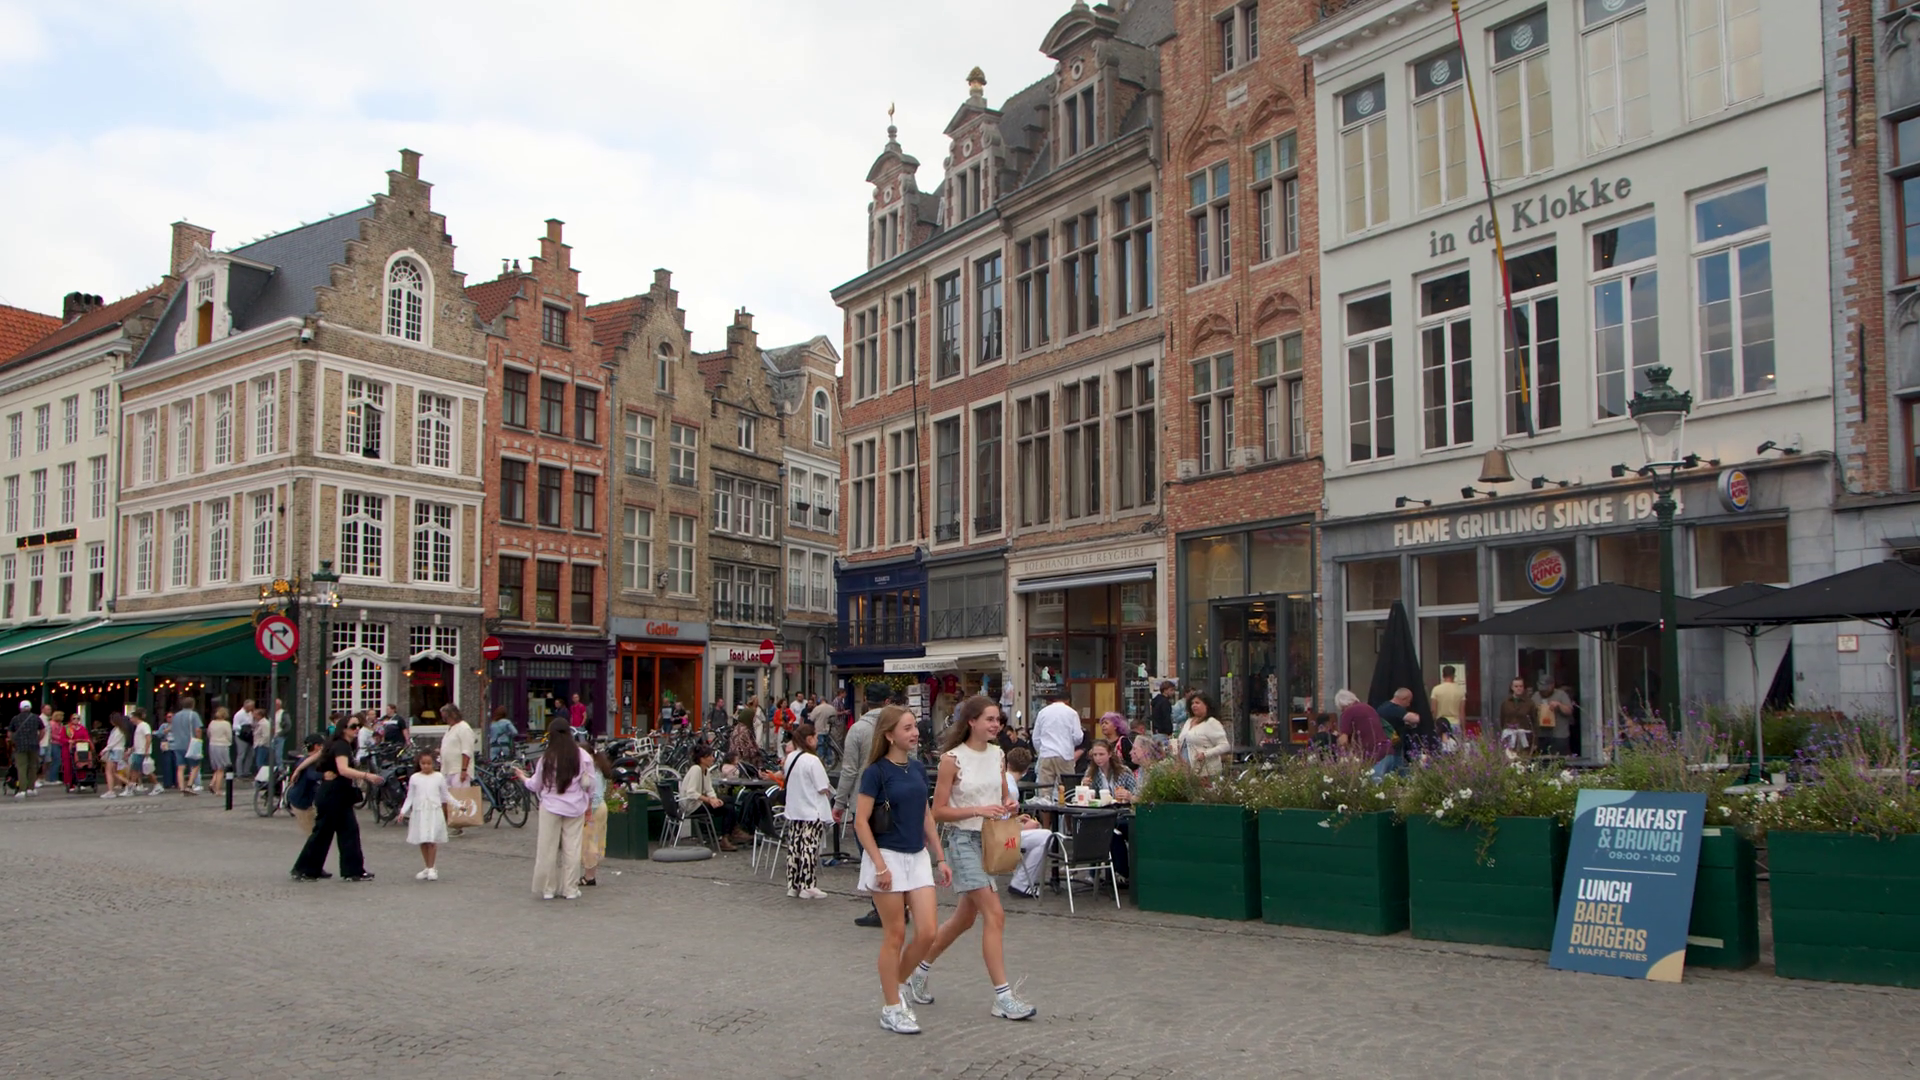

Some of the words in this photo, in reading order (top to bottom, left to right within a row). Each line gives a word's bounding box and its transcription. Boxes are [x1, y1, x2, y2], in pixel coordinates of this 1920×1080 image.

[1430, 230, 1456, 257] in
[1468, 215, 1496, 245] de
[1512, 177, 1631, 232] Klokke
[1731, 486, 1748, 499] KING
[1394, 518, 1450, 547] FLAME
[1456, 505, 1546, 540] GRILLING
[1553, 497, 1613, 529] SINCE
[1623, 488, 1684, 521] 194
[1024, 555, 1080, 571] BOEKHANDEL
[1081, 553, 1093, 564] DE
[1096, 547, 1145, 561] REYGHERE
[1531, 556, 1560, 572] BURGER
[1533, 562, 1562, 583] KING
[646, 621, 679, 637] Galler
[729, 649, 745, 660] Foot
[1594, 806, 1687, 831] BREAKFAST
[1598, 828, 1611, 849] &
[1614, 828, 1683, 853] BRUNCH
[1608, 850, 1640, 861] 09:00
[1651, 853, 1680, 863] 14:00
[1577, 878, 1632, 903] LUNCH
[1574, 900, 1623, 926] BAGEL
[1570, 923, 1647, 952] BURGERS
[1568, 946, 1575, 954] &
[1577, 946, 1617, 959] WAFFLE
[1619, 950, 1648, 962] FRIES
